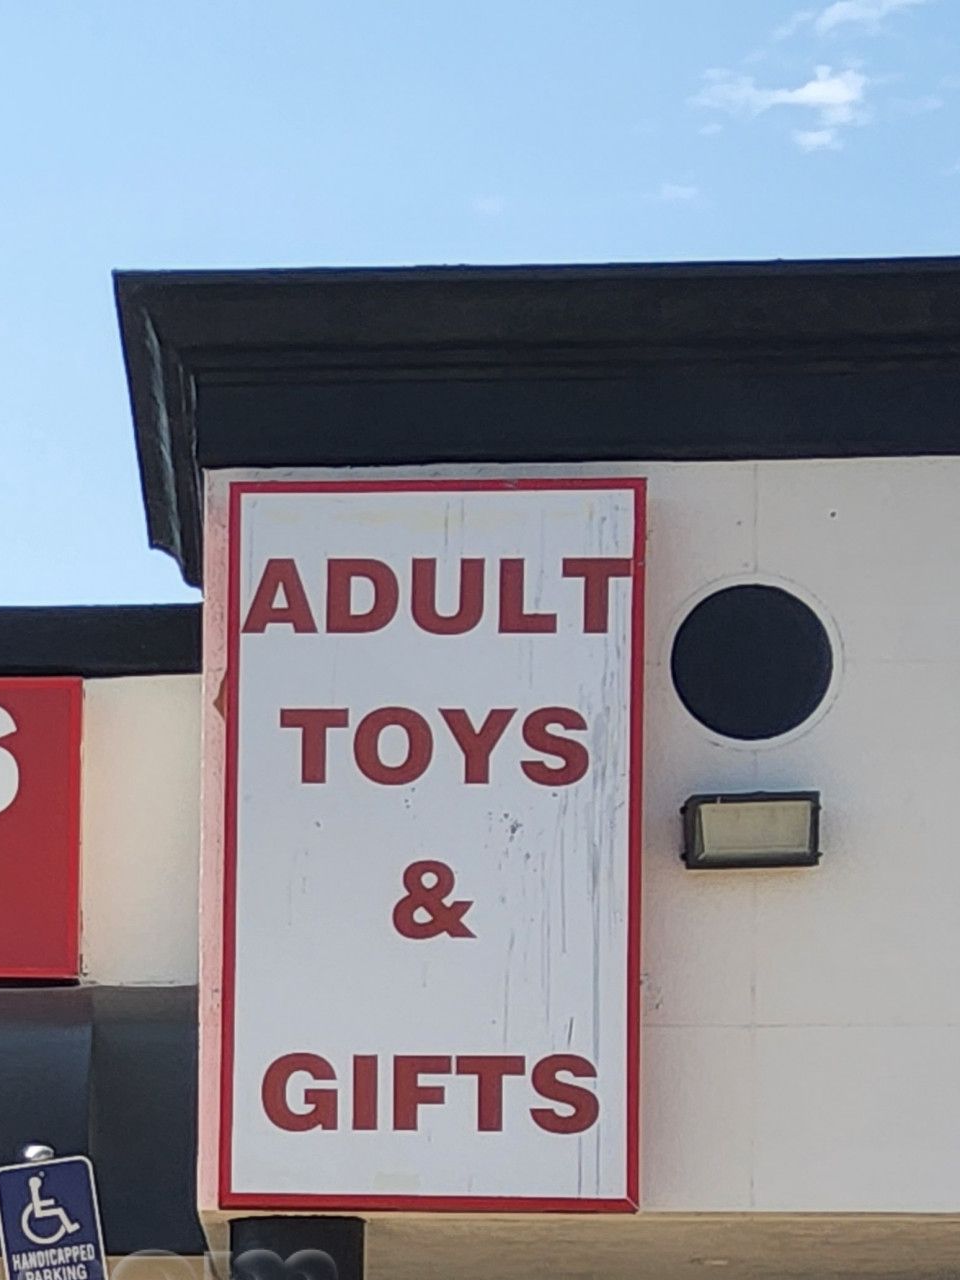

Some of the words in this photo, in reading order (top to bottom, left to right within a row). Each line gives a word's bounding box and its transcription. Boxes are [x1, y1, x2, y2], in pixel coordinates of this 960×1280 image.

[241, 557, 635, 635] ADULT
[280, 706, 590, 787] TOYS
[392, 860, 477, 939] &
[261, 1052, 600, 1134] GIFTS
[11, 1243, 96, 1272] HANDICAPPED
